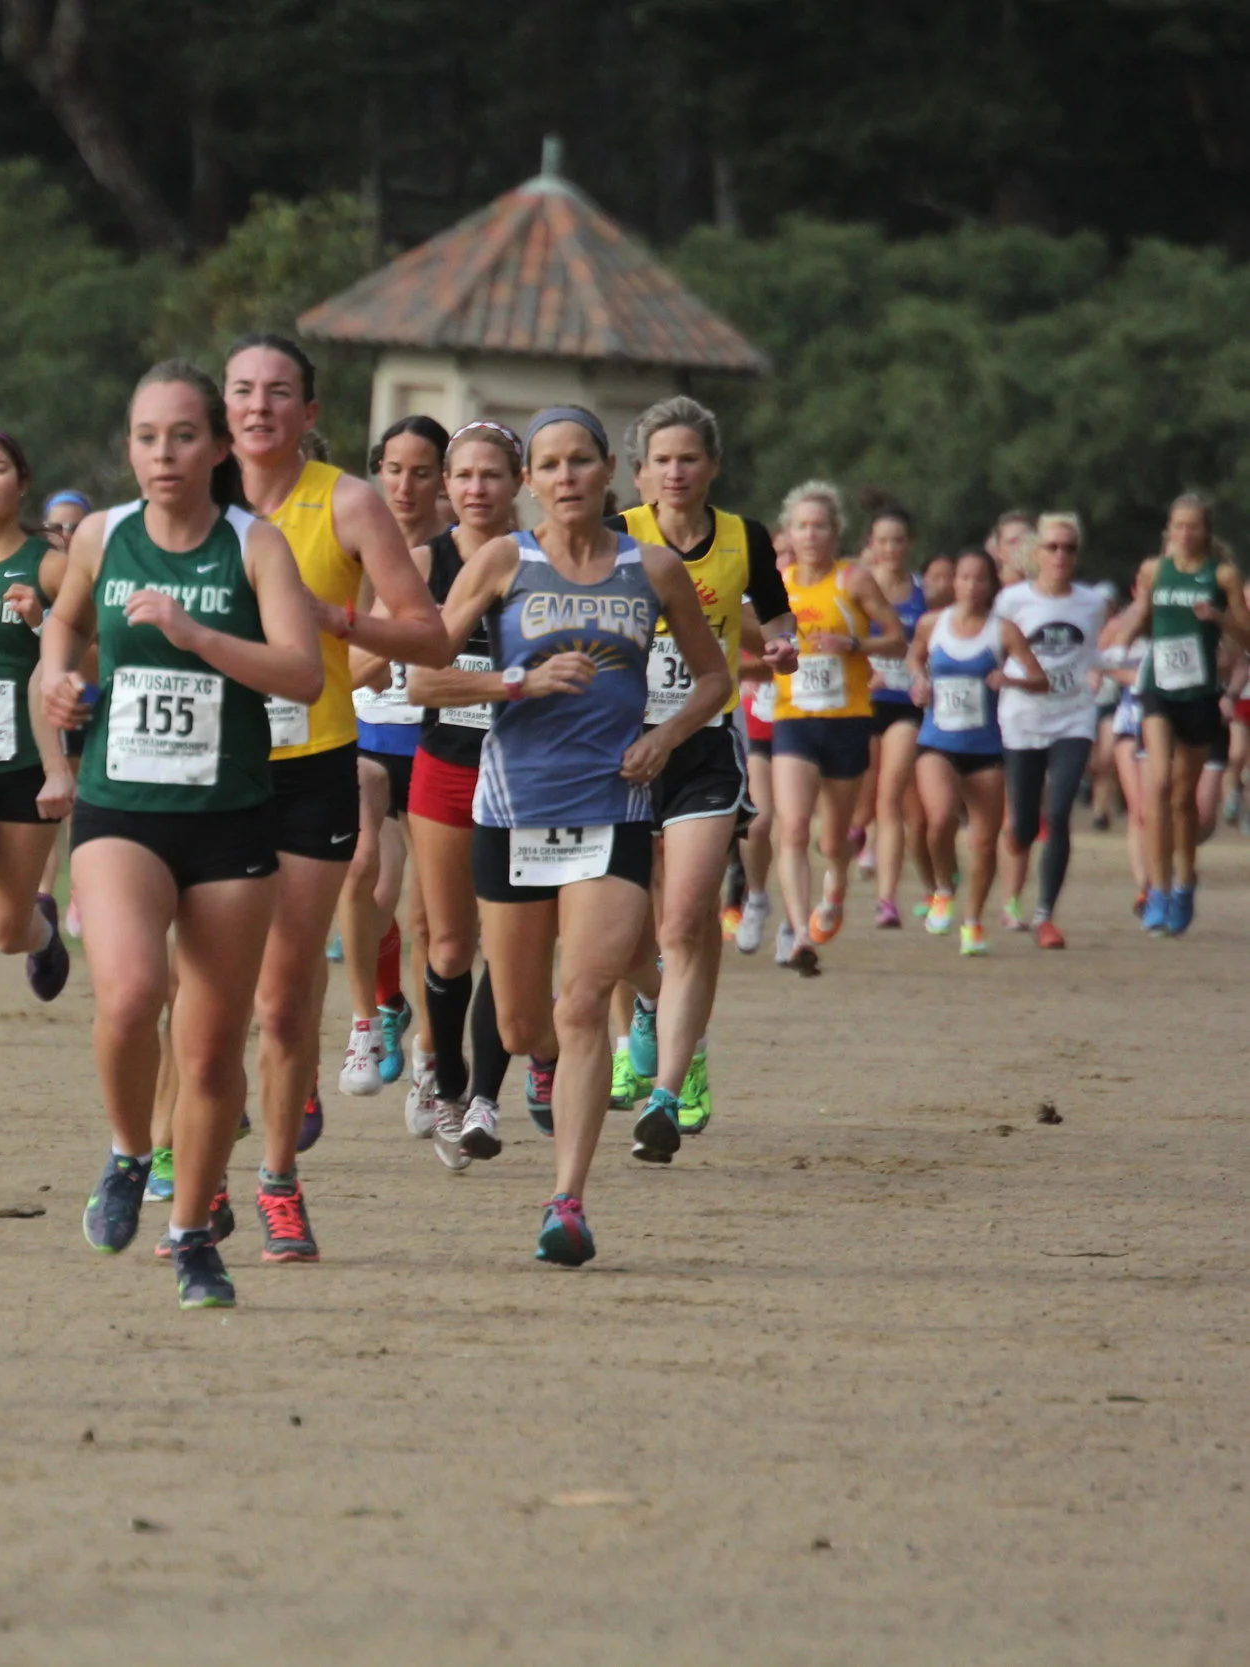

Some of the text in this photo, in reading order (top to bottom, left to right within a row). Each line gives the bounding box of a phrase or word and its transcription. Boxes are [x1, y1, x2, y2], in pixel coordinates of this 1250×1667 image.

[200, 586, 231, 614] DC
[120, 672, 213, 695] PA/USATF XC
[135, 694, 194, 737] 155
